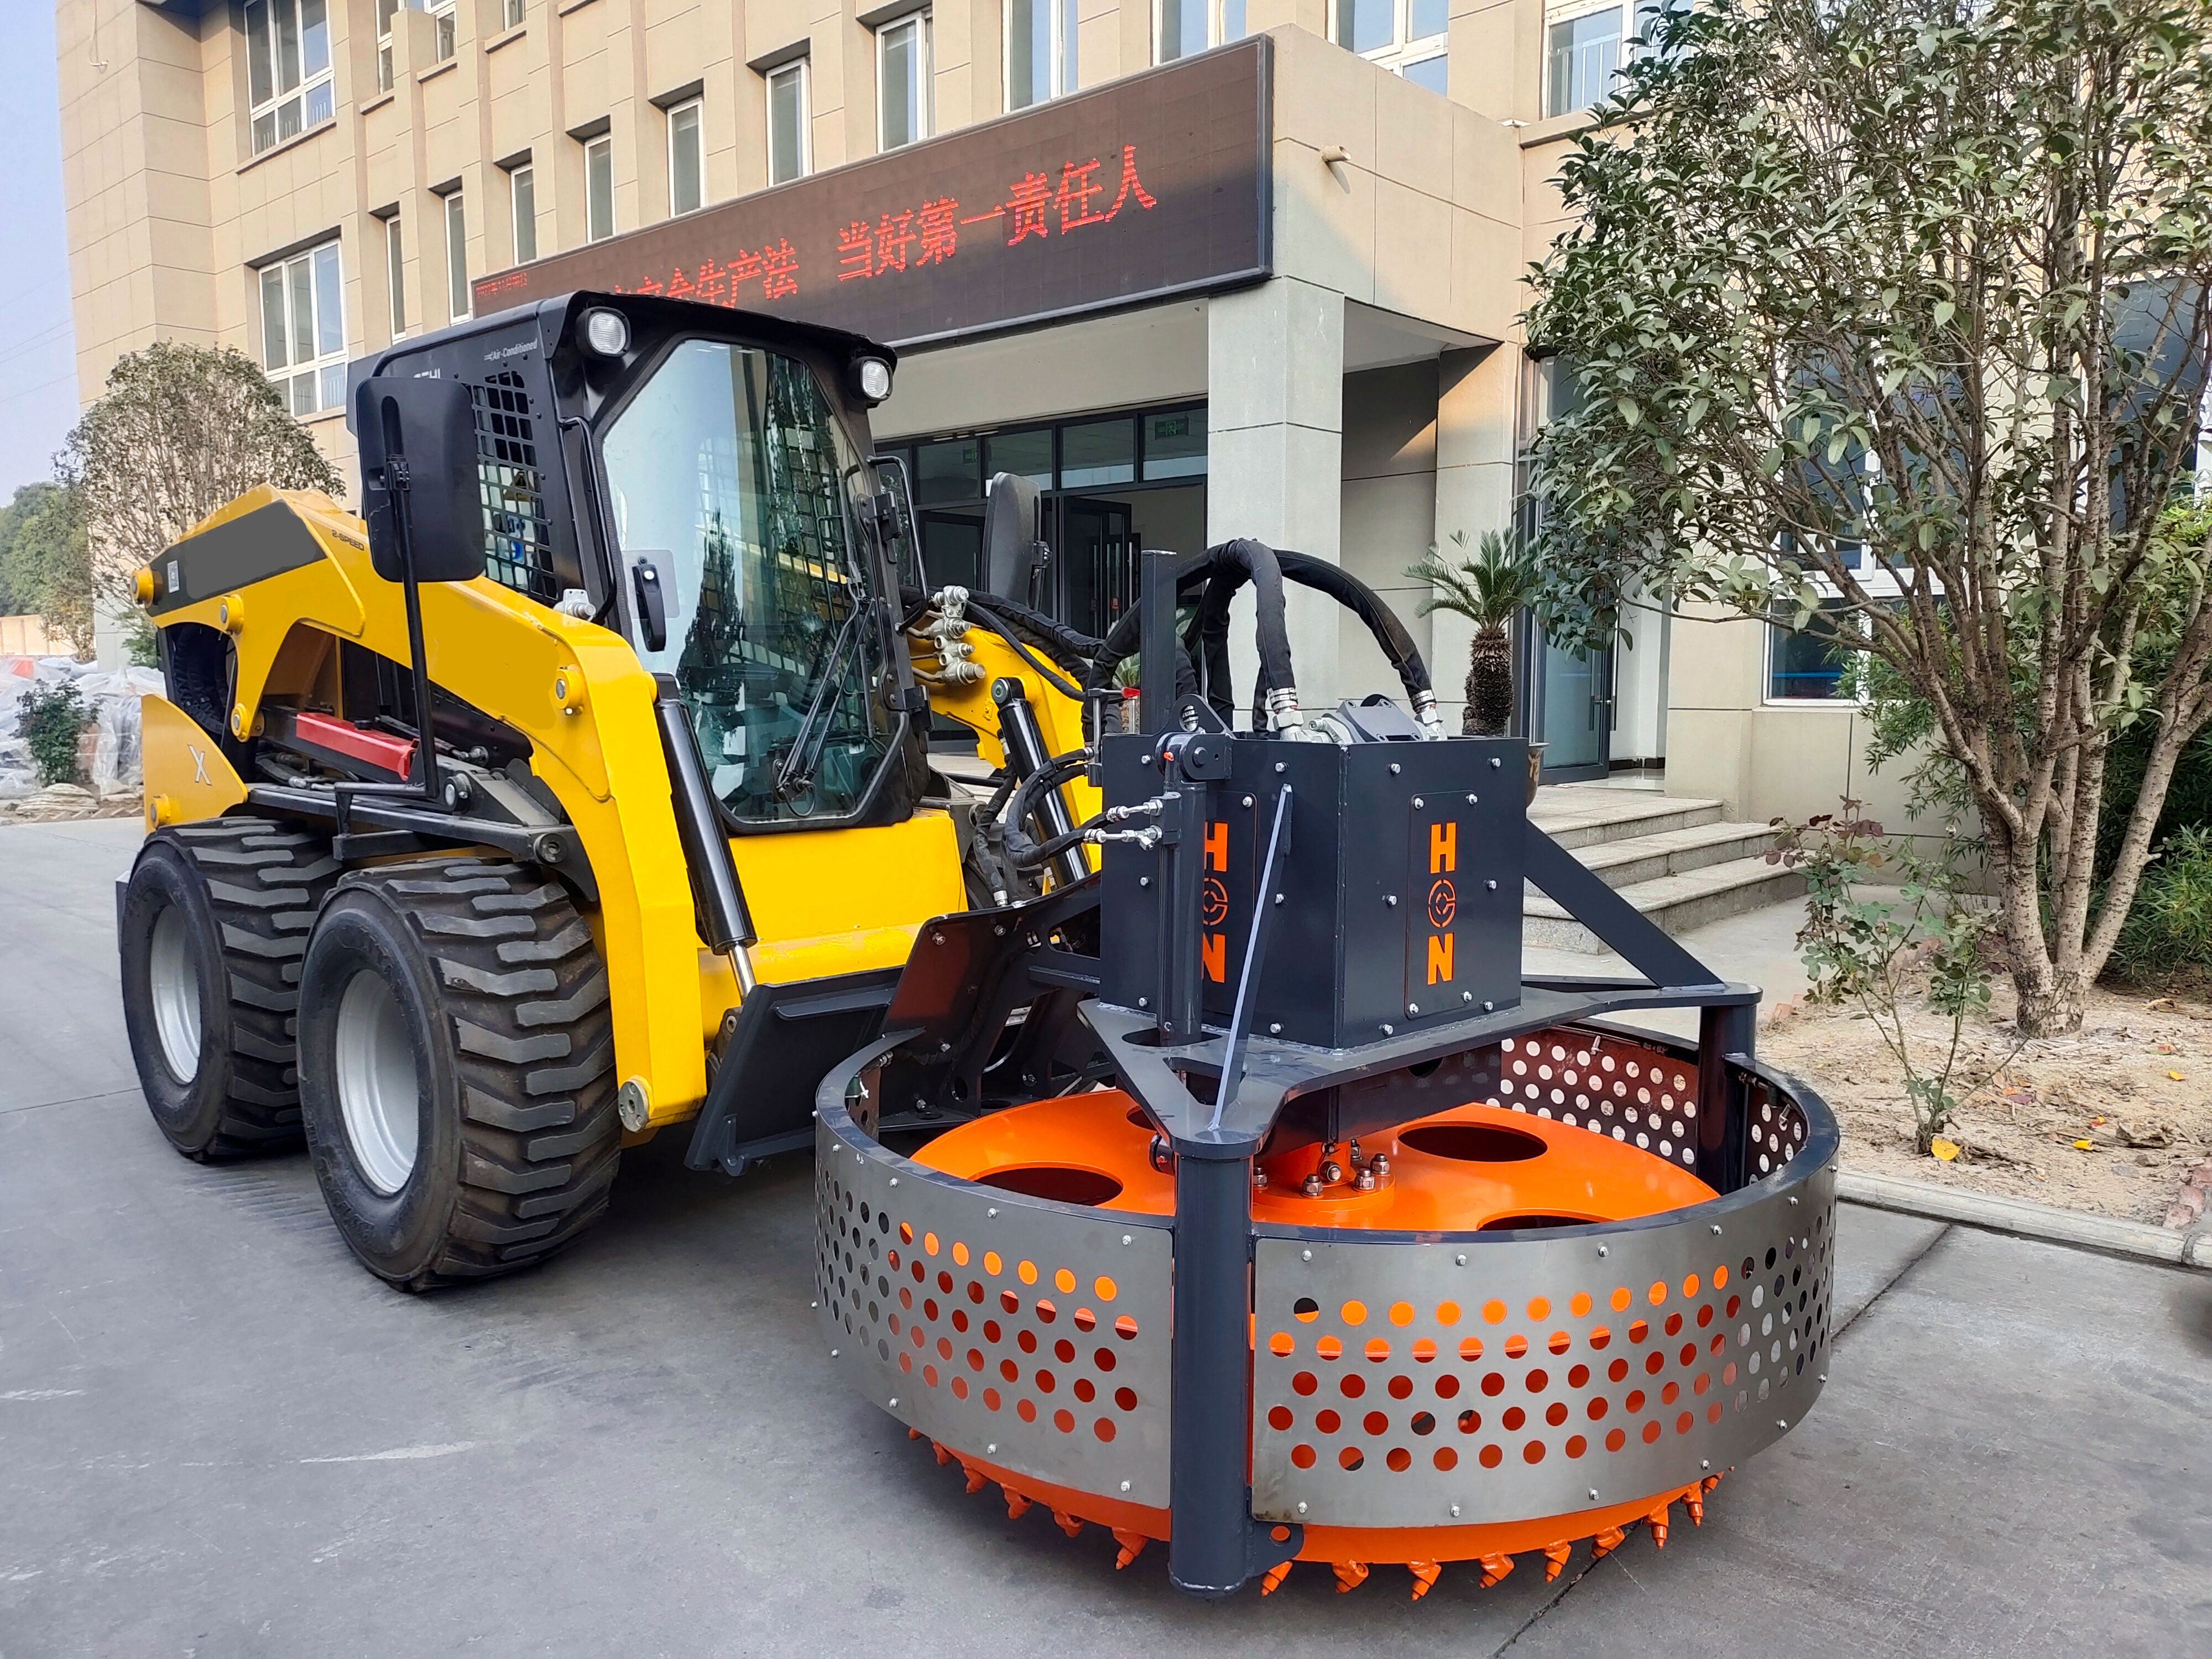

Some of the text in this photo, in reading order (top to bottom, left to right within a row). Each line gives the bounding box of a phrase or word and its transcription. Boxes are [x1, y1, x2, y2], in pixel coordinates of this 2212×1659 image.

[838, 144, 1157, 281] 当好第一责任人
[491, 337, 538, 361] Air-Conditioned
[332, 529, 364, 551] 2-SPEED
[187, 743, 212, 786] X
